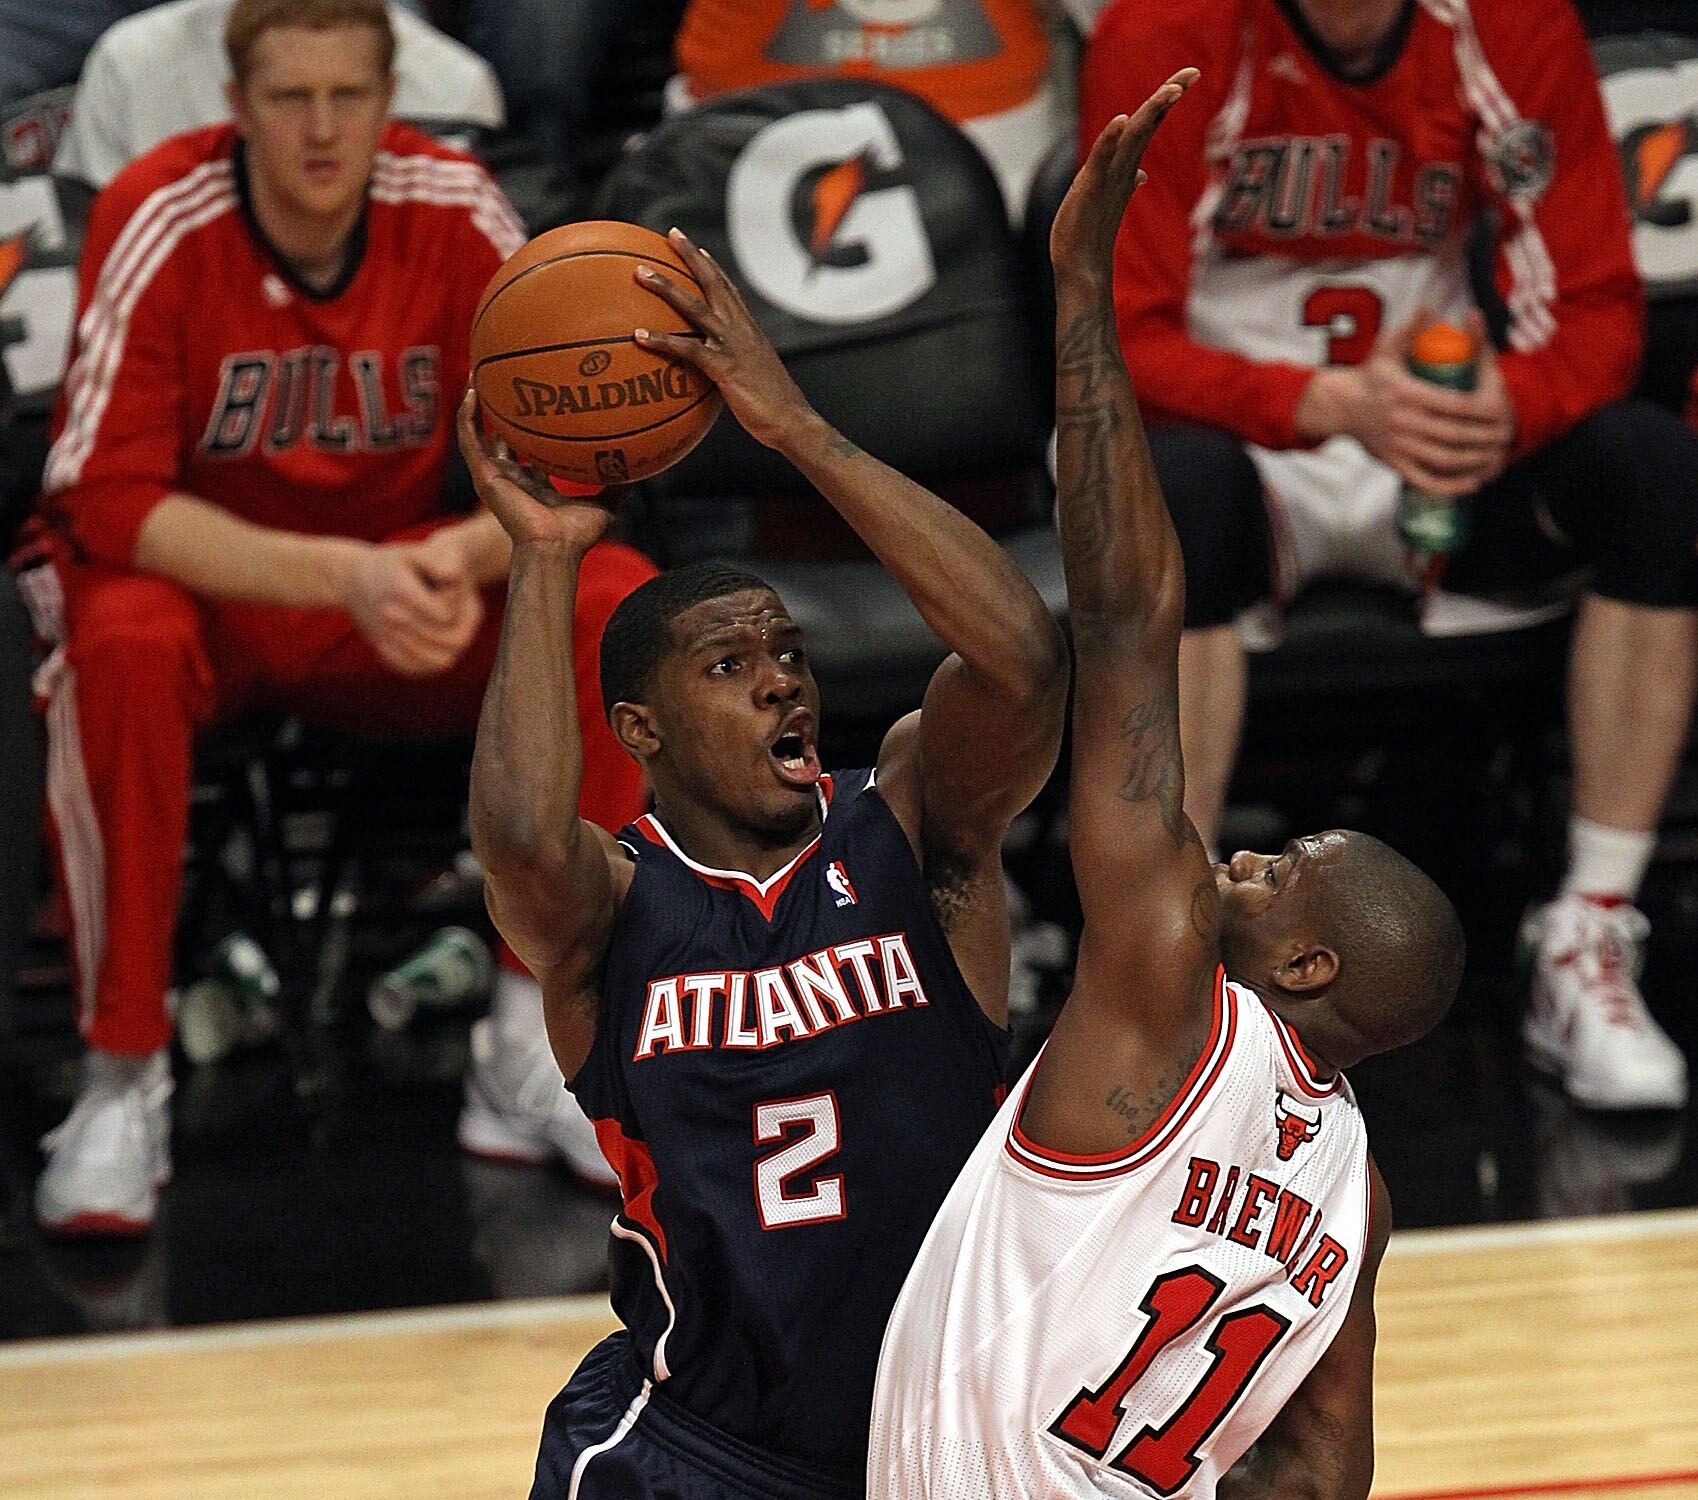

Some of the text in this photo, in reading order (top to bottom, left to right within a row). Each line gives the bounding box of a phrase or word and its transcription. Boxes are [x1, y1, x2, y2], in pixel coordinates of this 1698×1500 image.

[726, 101, 938, 325] G
[1208, 133, 1456, 246] BULLS
[200, 345, 440, 457] BULLS
[512, 361, 691, 417] SPALDING
[633, 932, 929, 1062] ATLANTA
[753, 1089, 847, 1231] 2
[1045, 1262, 1293, 1499] 11
